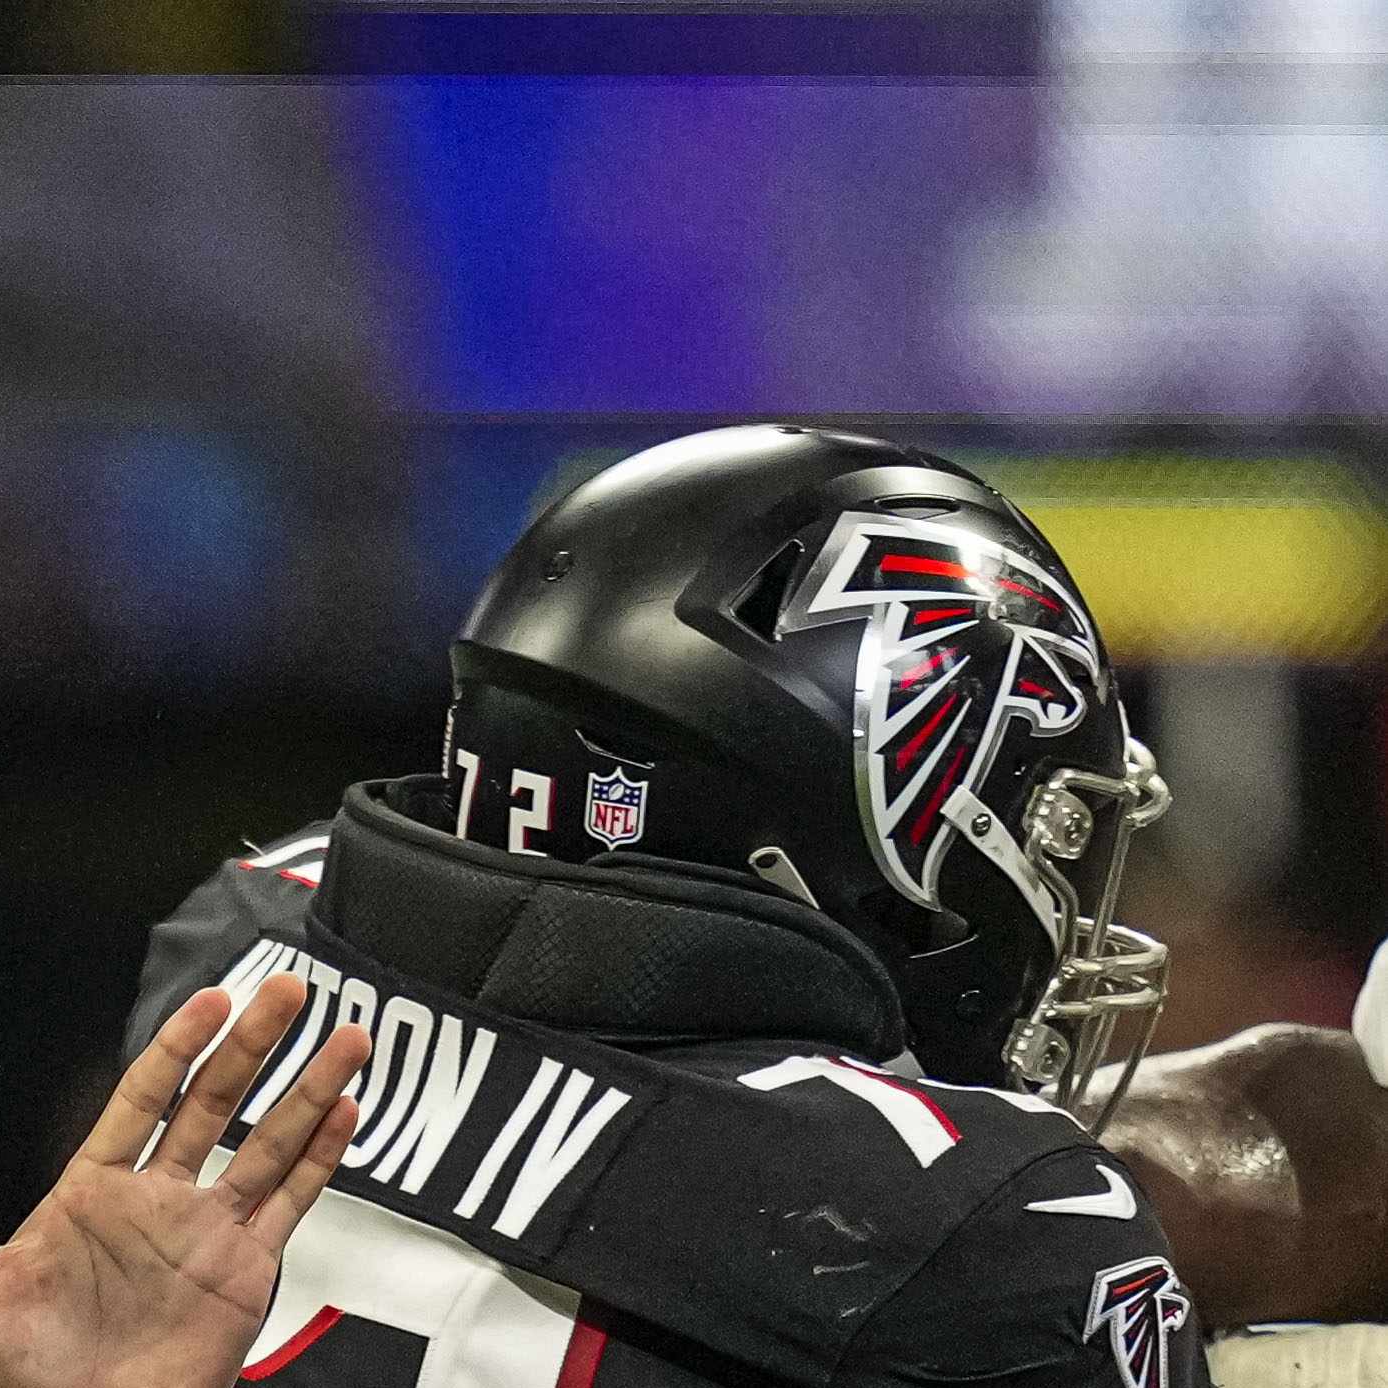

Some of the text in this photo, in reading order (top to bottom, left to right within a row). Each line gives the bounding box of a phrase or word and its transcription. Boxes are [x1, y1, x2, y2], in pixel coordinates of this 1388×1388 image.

[456, 748, 556, 857] 72
[593, 802, 634, 837] NFL
[453, 1057, 632, 1239] IV
